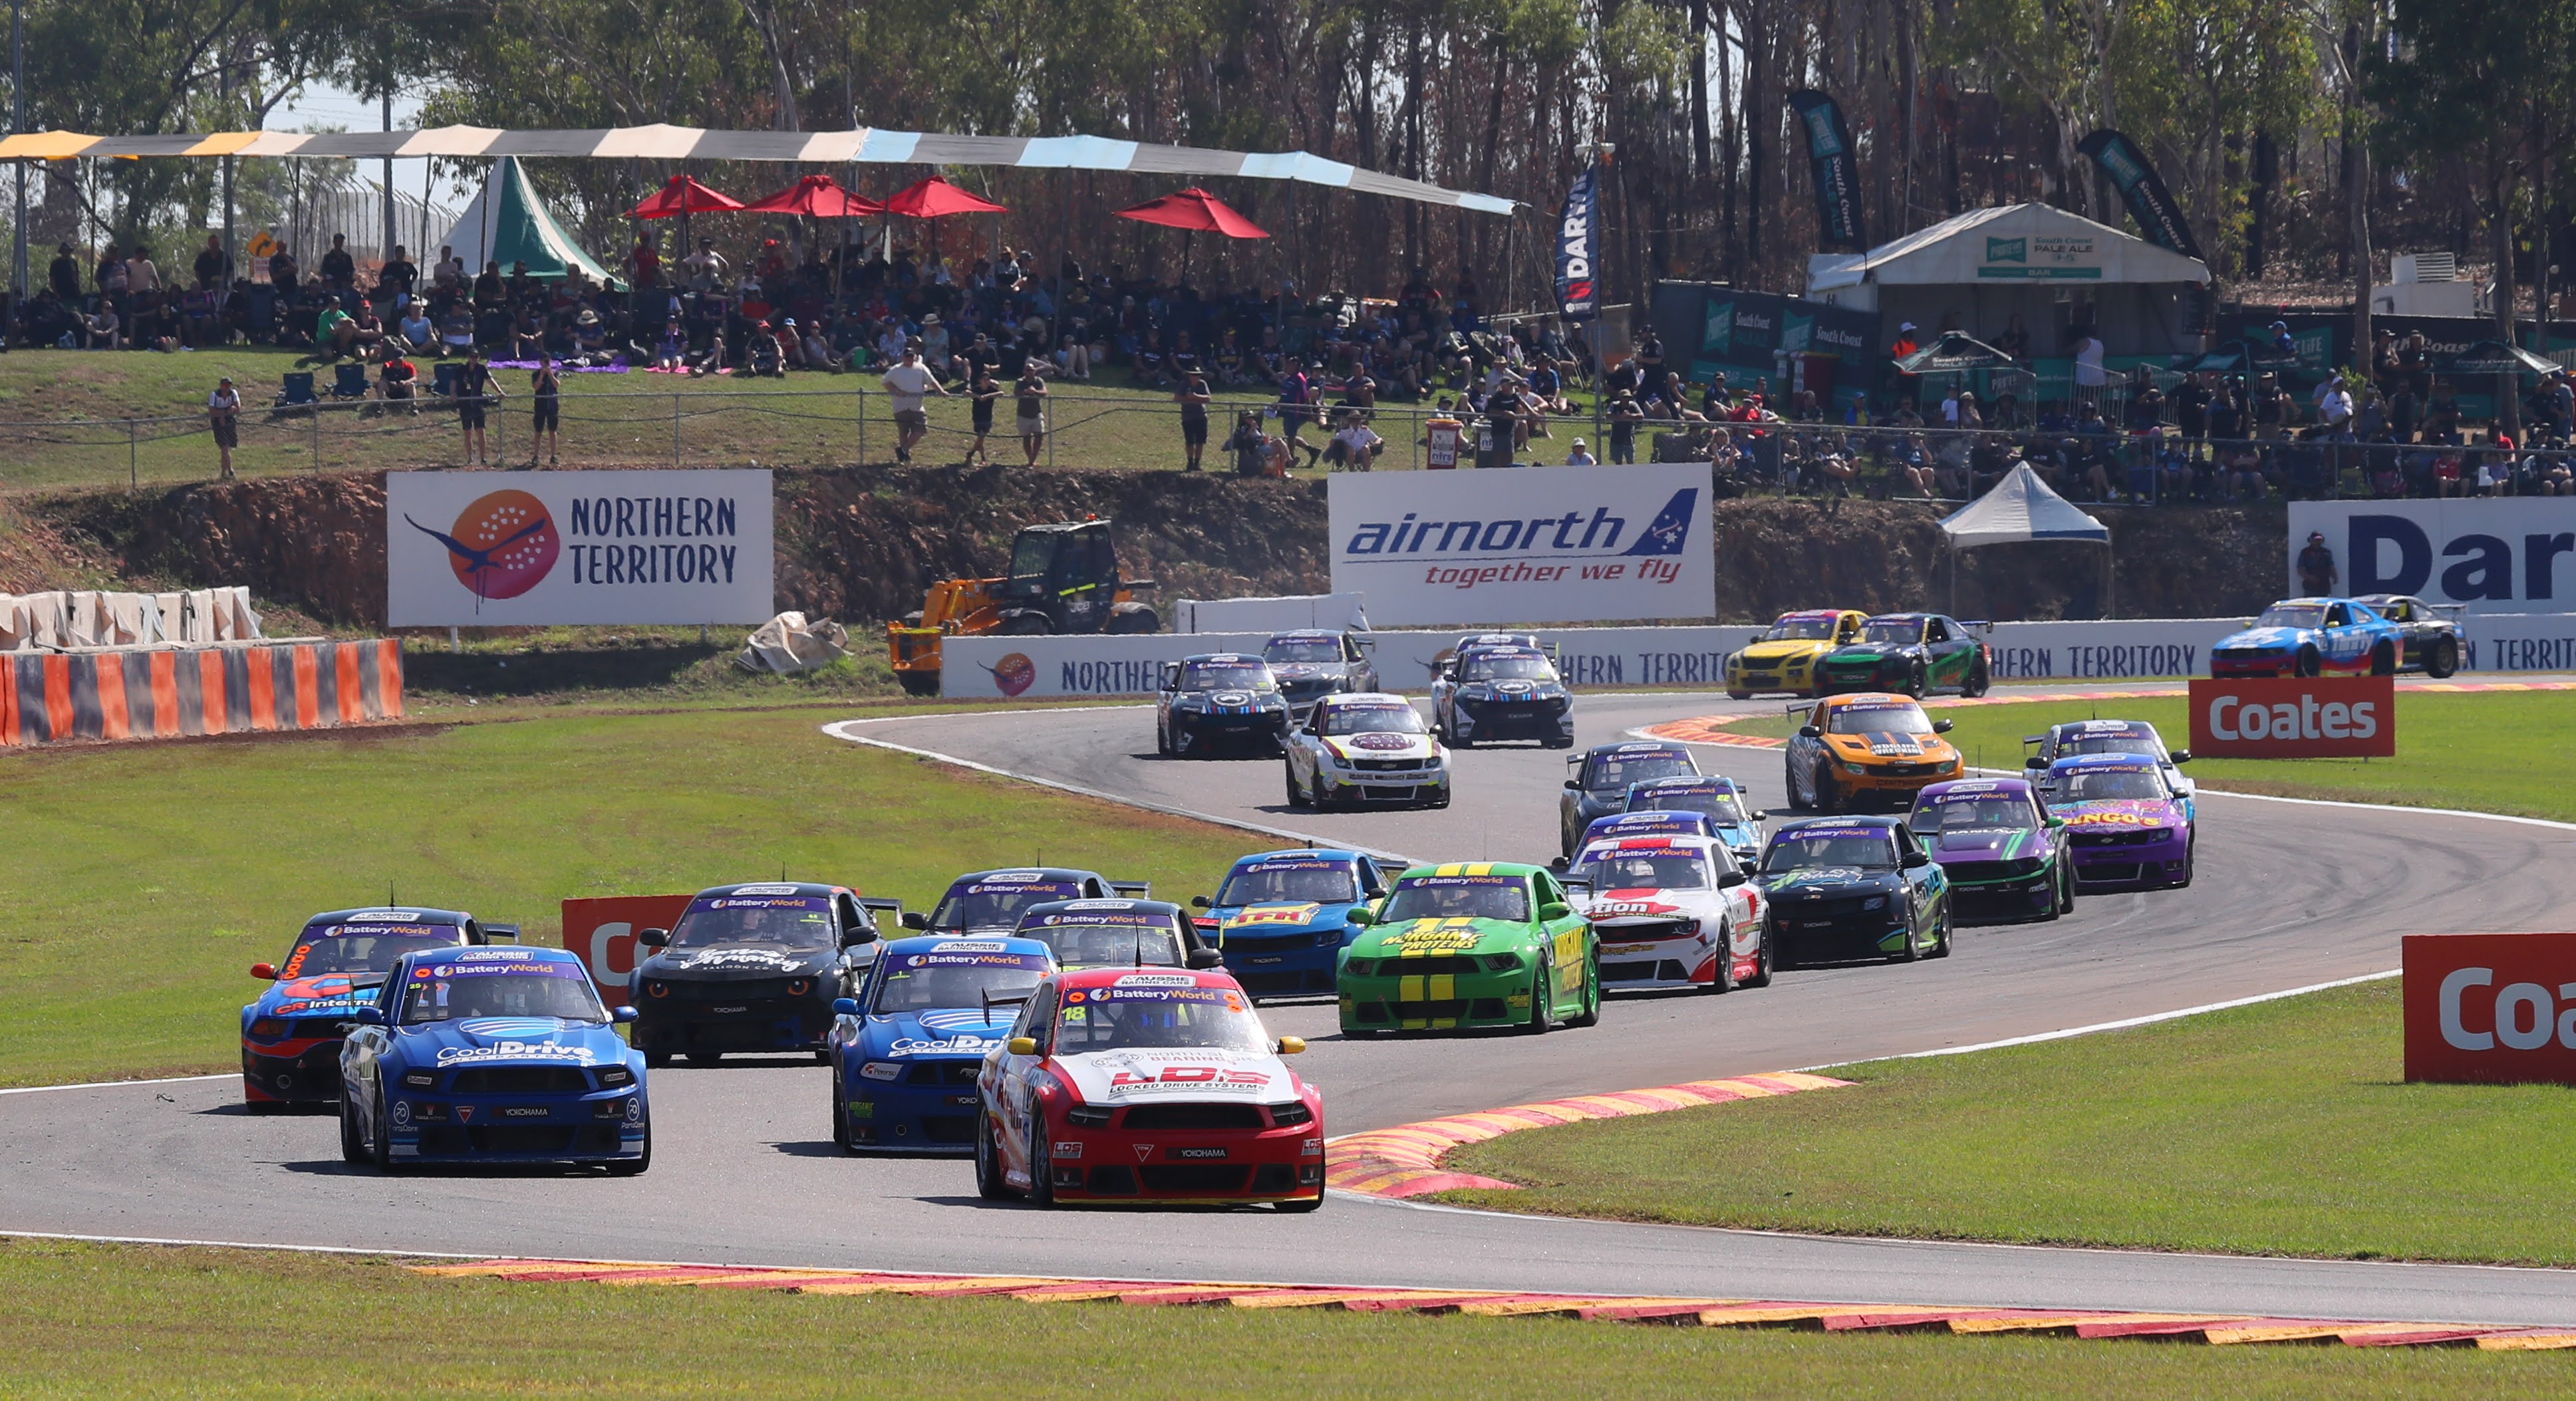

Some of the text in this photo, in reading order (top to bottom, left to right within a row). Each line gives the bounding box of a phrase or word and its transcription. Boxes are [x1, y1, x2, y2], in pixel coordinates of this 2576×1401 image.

[1564, 174, 1590, 279] DARWI
[2034, 245, 2065, 253] PALE
[2069, 245, 2094, 253] ALE
[571, 497, 736, 537] NORTHERN
[1346, 507, 1626, 555] airnorth
[2349, 514, 2575, 600] Dar
[568, 544, 737, 584] TERRITORY
[1425, 558, 1683, 590] together we fly
[2493, 638, 2576, 670] TERRIT
[2068, 644, 2196, 678] TERRITORY
[1062, 660, 1169, 694] NORTHER
[2209, 694, 2376, 741] Coates
[1614, 848, 1693, 858] BatteryWorld
[1262, 862, 1330, 870] BatteryWorld
[1428, 876, 1504, 885] BatteryWorld
[983, 884, 1056, 893] BatteryWorld
[728, 899, 806, 908] BatteryWorld
[1584, 902, 1649, 914] ction
[1062, 915, 1147, 925] BatteryWorld
[343, 926, 431, 936] BatteryWorld
[1399, 940, 1475, 950] PROTEINS
[928, 955, 1022, 965] BatteryWorld
[455, 963, 554, 974] BatteryWorld
[1113, 989, 1216, 1001] BatteryWorld
[276, 1001, 307, 1014] CR
[1061, 1005, 1086, 1021] 18
[436, 1040, 595, 1061] CoolDrive
[873, 1068, 897, 1077] Perenso
[1110, 1067, 1272, 1086] LDS
[1109, 1083, 1159, 1094] LOCKED
[505, 1108, 548, 1116] YOKOHAMA
[1056, 1142, 1082, 1152] LDS
[1181, 1149, 1226, 1158] YOKOHAMA
